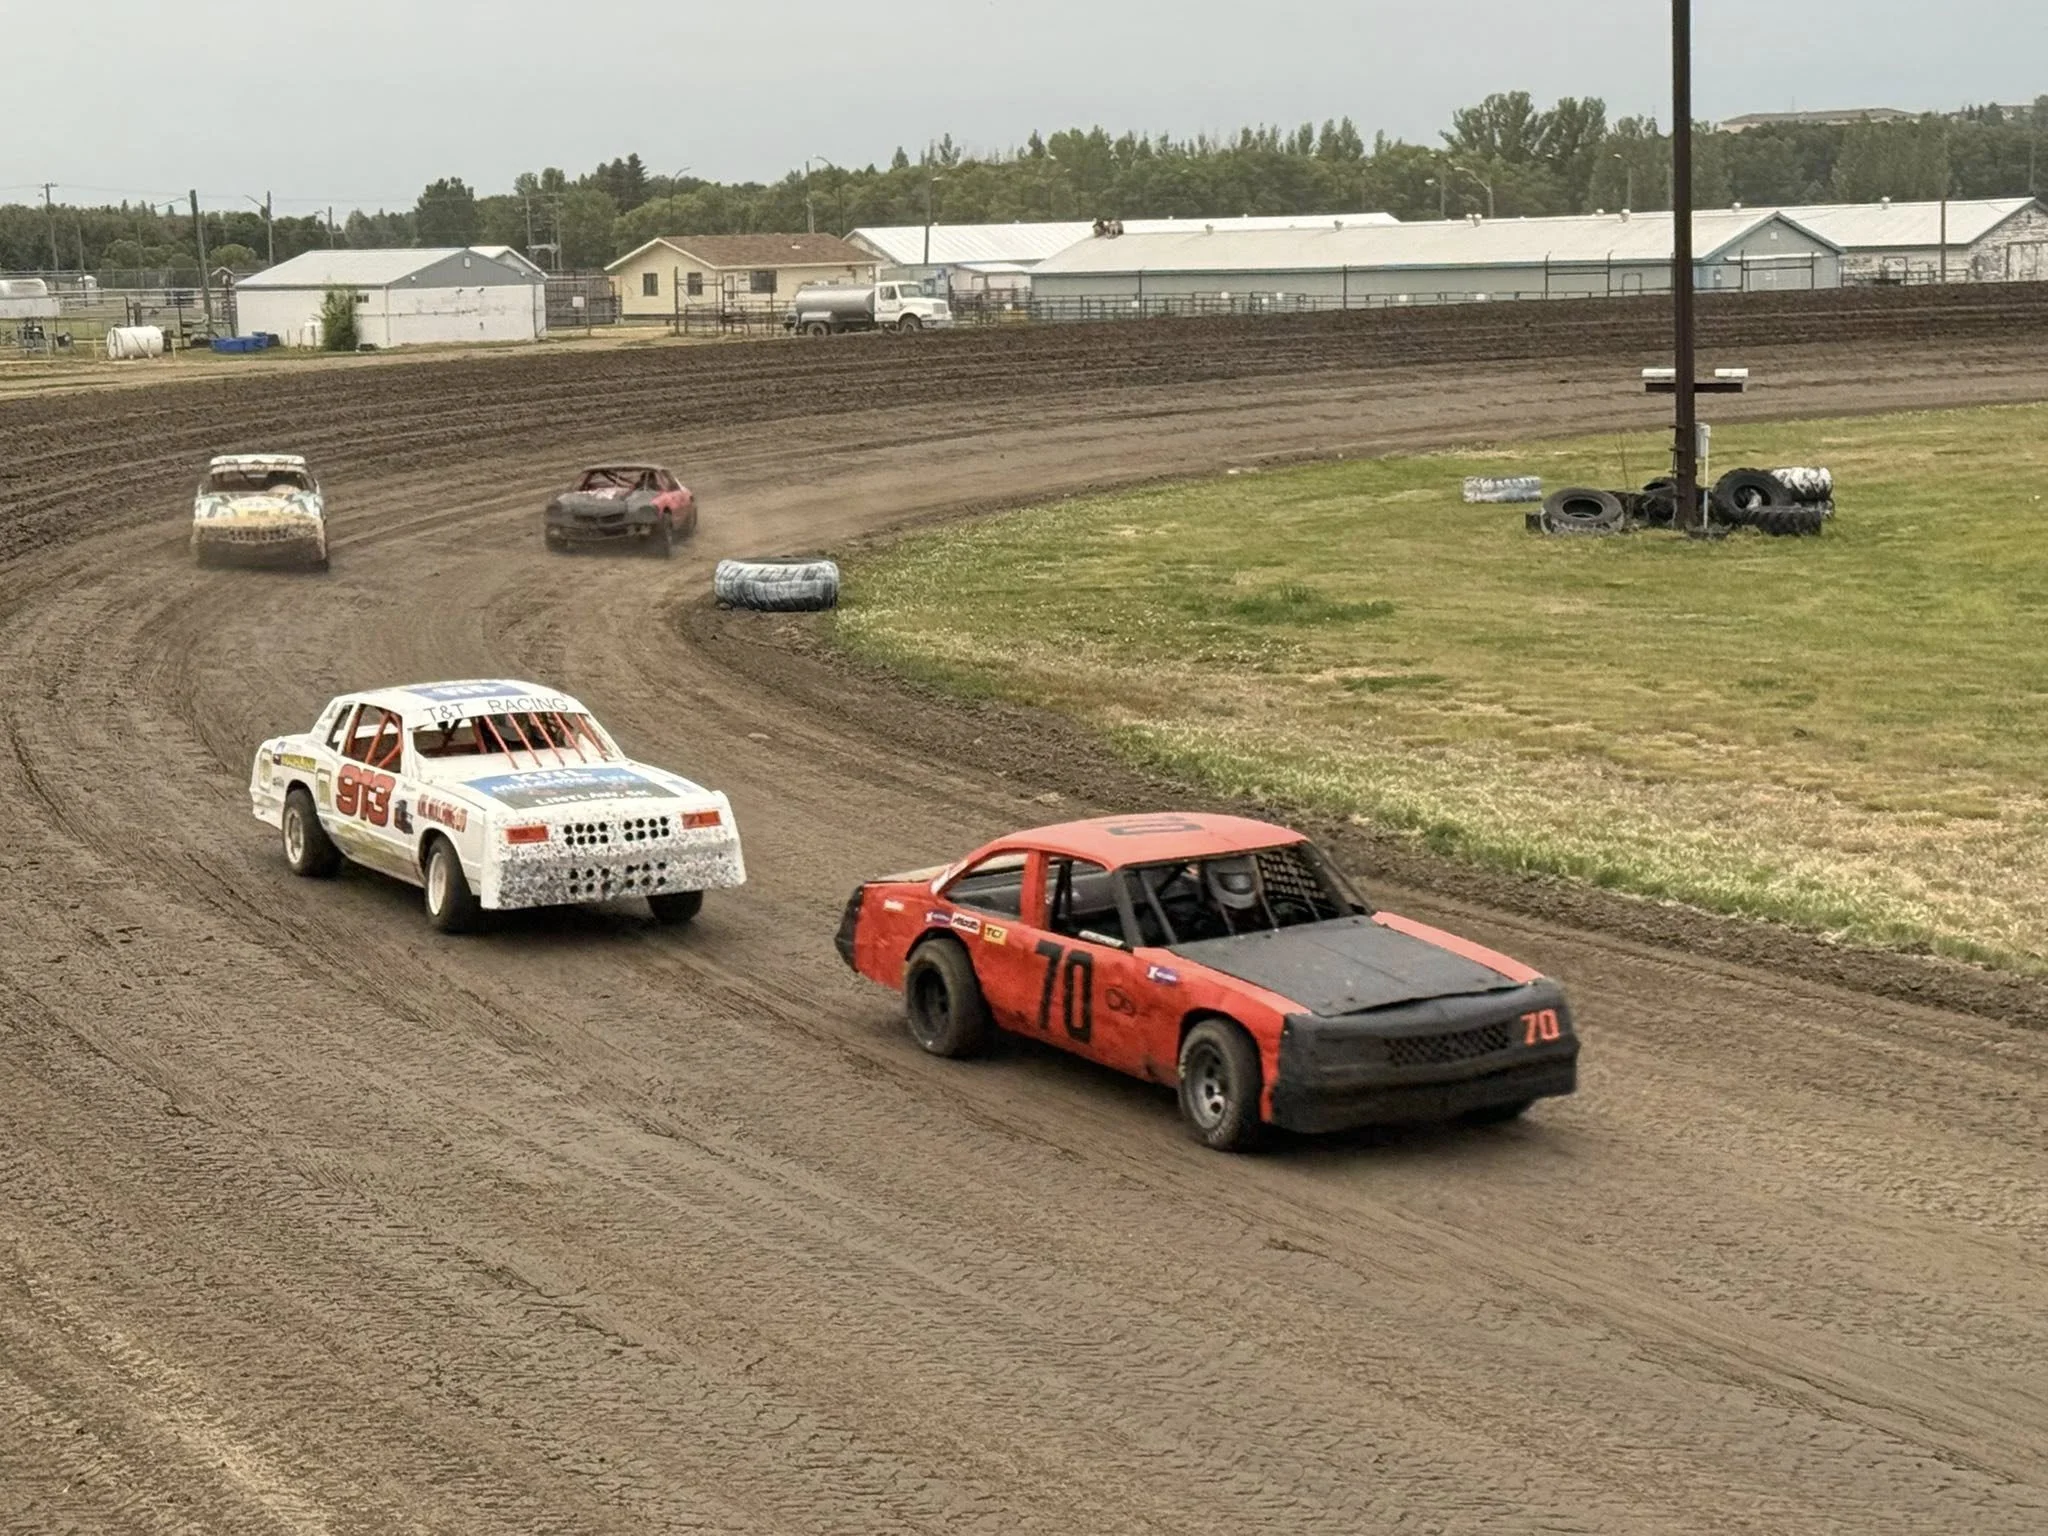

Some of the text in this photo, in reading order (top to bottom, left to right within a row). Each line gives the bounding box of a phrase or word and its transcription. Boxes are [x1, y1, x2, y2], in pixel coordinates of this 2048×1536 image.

[424, 697, 569, 722] T&T RACING
[336, 763, 397, 828] 913
[1034, 938, 1094, 1043] 70
[1520, 1008, 1560, 1046] 70
